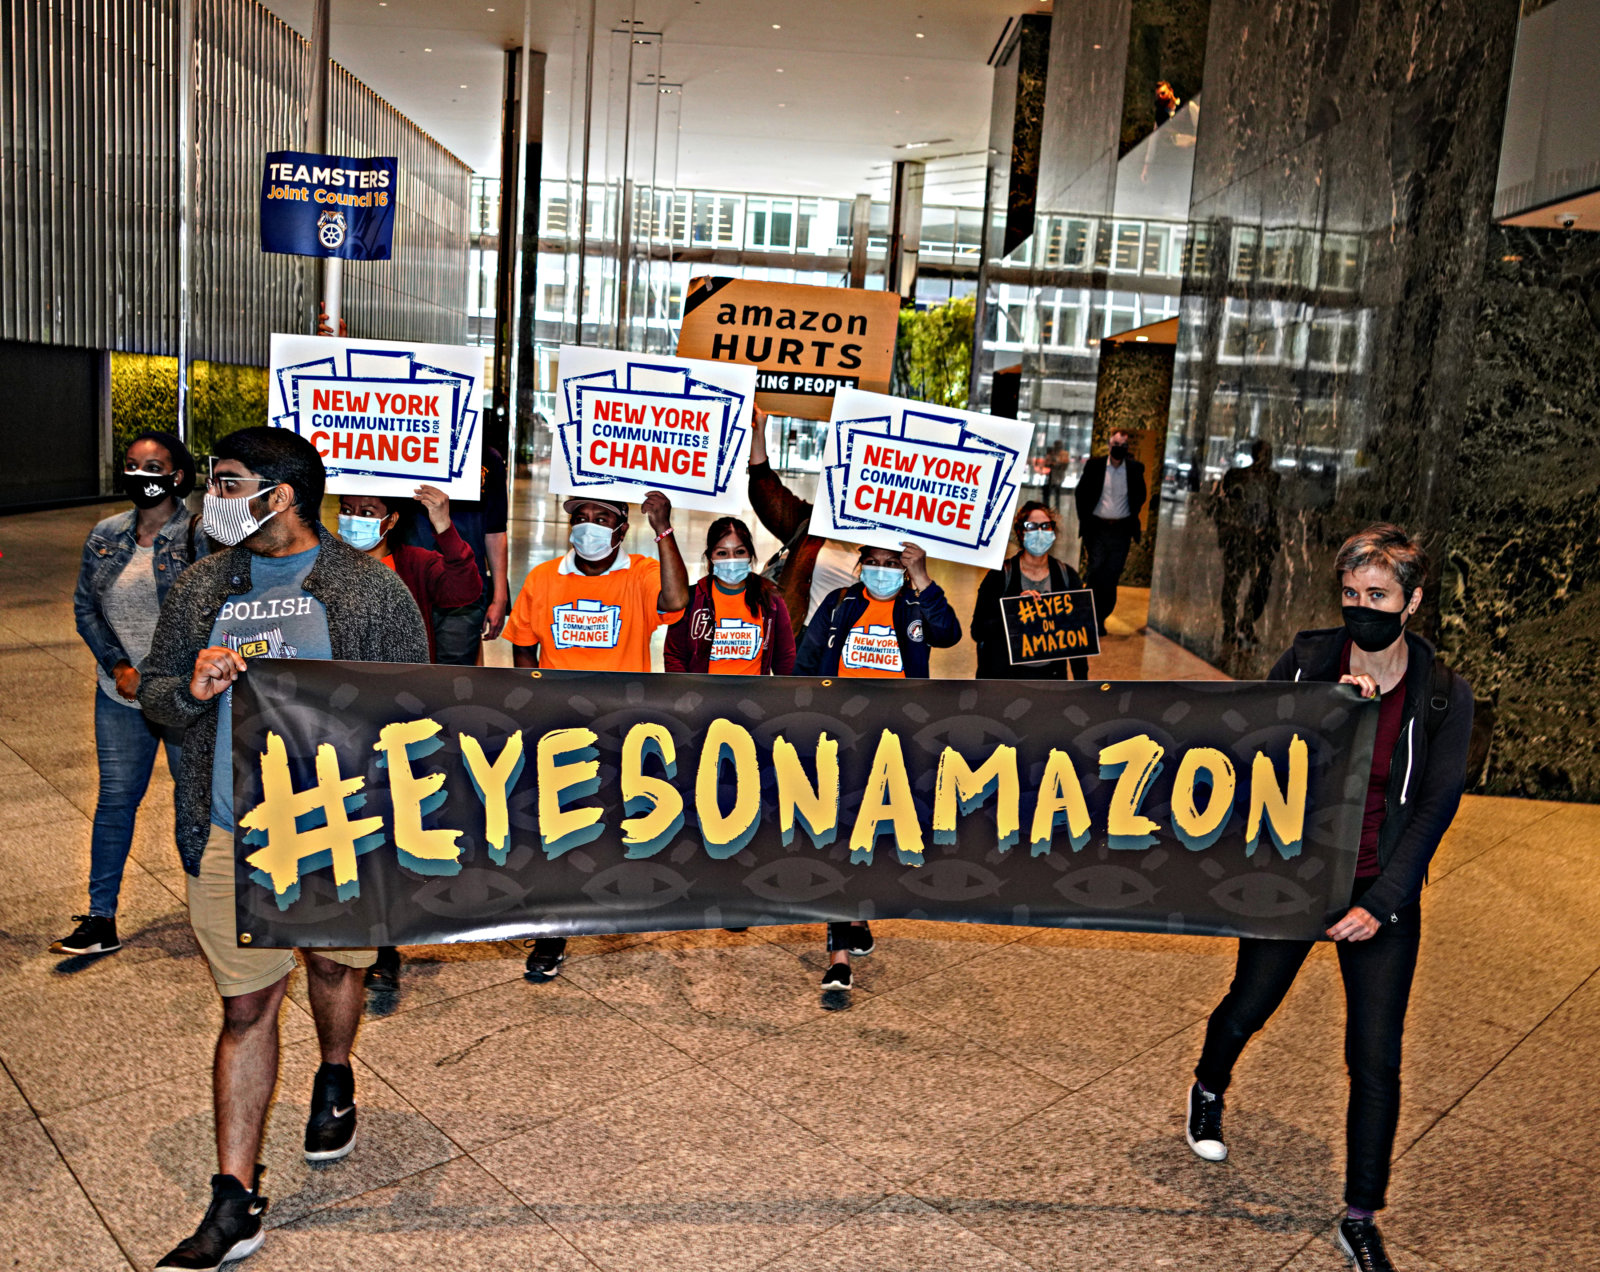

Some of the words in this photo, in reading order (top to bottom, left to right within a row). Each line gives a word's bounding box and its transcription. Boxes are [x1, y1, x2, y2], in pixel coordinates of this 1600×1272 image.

[269, 163, 390, 189] TEAMSTERS
[267, 185, 309, 201] Joint
[314, 189, 372, 207] Council
[374, 192, 388, 206] 16
[717, 303, 868, 336] amazon
[711, 333, 863, 369] HURTS
[313, 389, 370, 413] NEW
[375, 392, 440, 417] YORK
[312, 414, 430, 433] COMMUNITIES
[432, 420, 440, 434] FOR
[594, 400, 647, 425] NEW
[651, 406, 710, 433] YORK
[310, 431, 439, 464] CHANGE
[592, 423, 700, 448] COMMUNITIES
[701, 435, 709, 449] FOR
[589, 440, 708, 478] CHANGE
[863, 444, 918, 473] NEW
[922, 454, 982, 486] YORK
[860, 468, 969, 500] COMMUNITIES
[969, 488, 978, 502] FOR
[854, 485, 975, 530] CHANGE
[215, 596, 314, 620] BOLISH
[563, 614, 585, 624] NEW
[586, 614, 609, 624] YORK
[1018, 594, 1074, 624] #EYES
[562, 630, 609, 642] CHANGE
[563, 623, 605, 631] COMMUNITIES
[714, 631, 728, 640] EW
[729, 631, 752, 640] YORK
[1042, 619, 1057, 633] ON
[852, 644, 895, 654] COMMUNITIES
[853, 636, 875, 646] NEW
[1022, 626, 1089, 657] AMAZON
[851, 651, 899, 666] CHANGE
[239, 718, 1309, 911] #EYESONAMAZON
